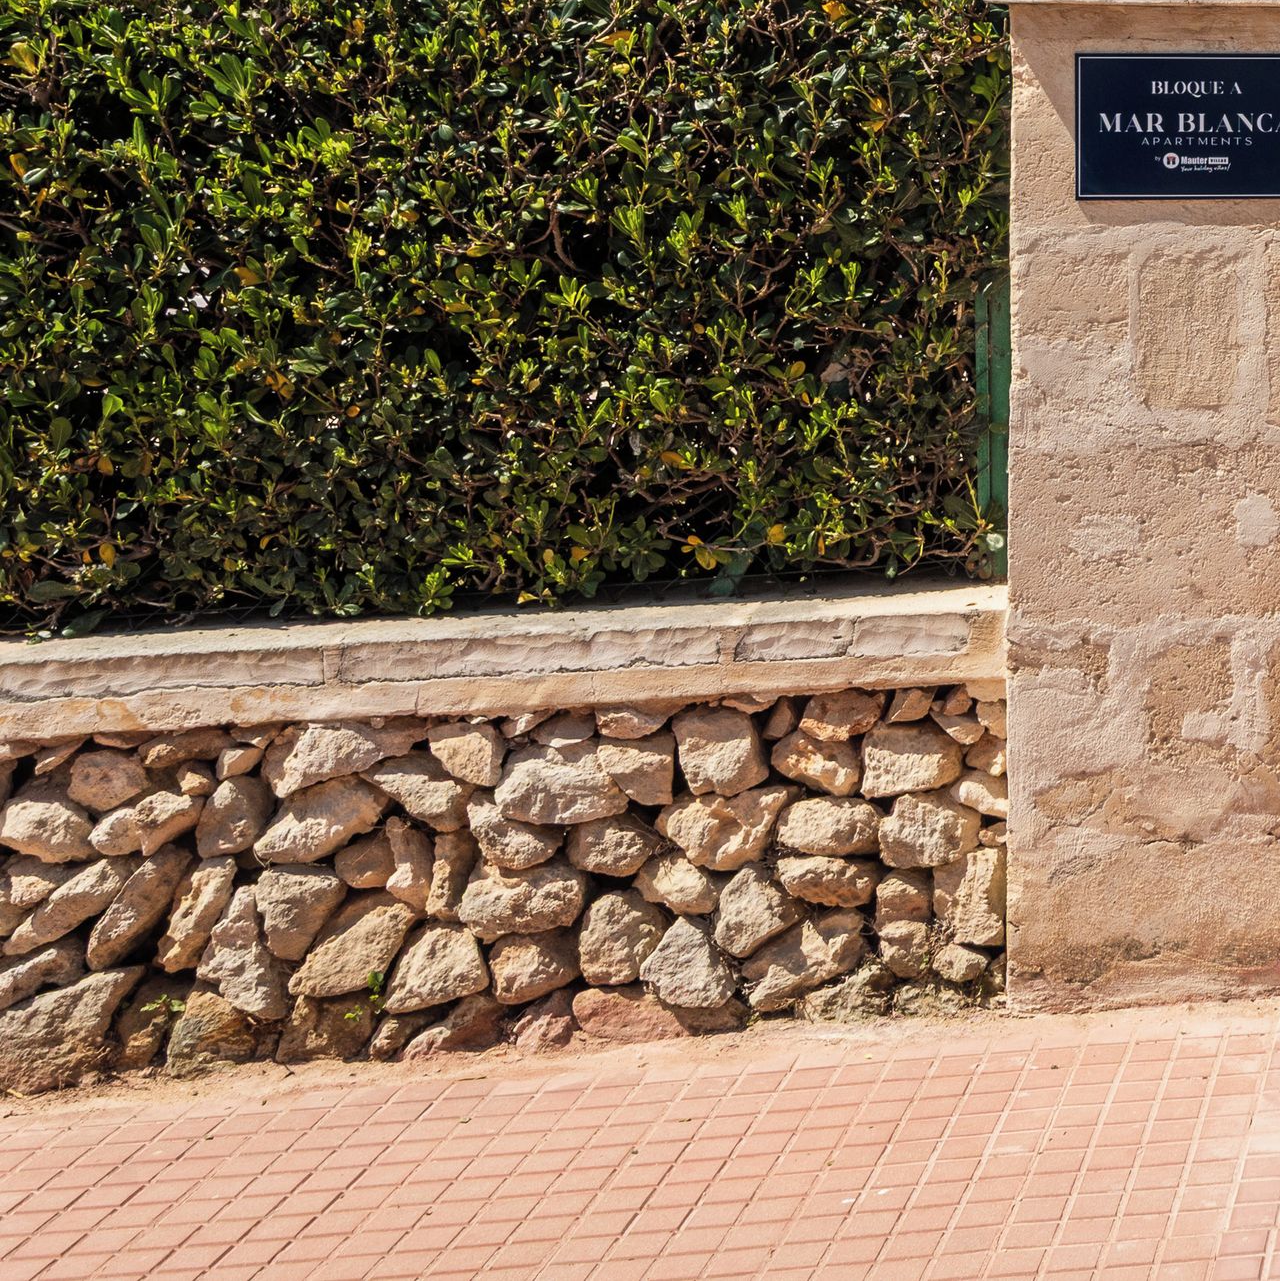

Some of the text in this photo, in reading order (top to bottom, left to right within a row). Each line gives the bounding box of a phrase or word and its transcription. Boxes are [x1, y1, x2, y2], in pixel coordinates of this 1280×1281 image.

[1151, 80, 1242, 98] BLOQUE A
[1099, 113, 1164, 133] MAR
[1141, 136, 1253, 146] APARTMENTS
[1181, 156, 1207, 165] Mauter
